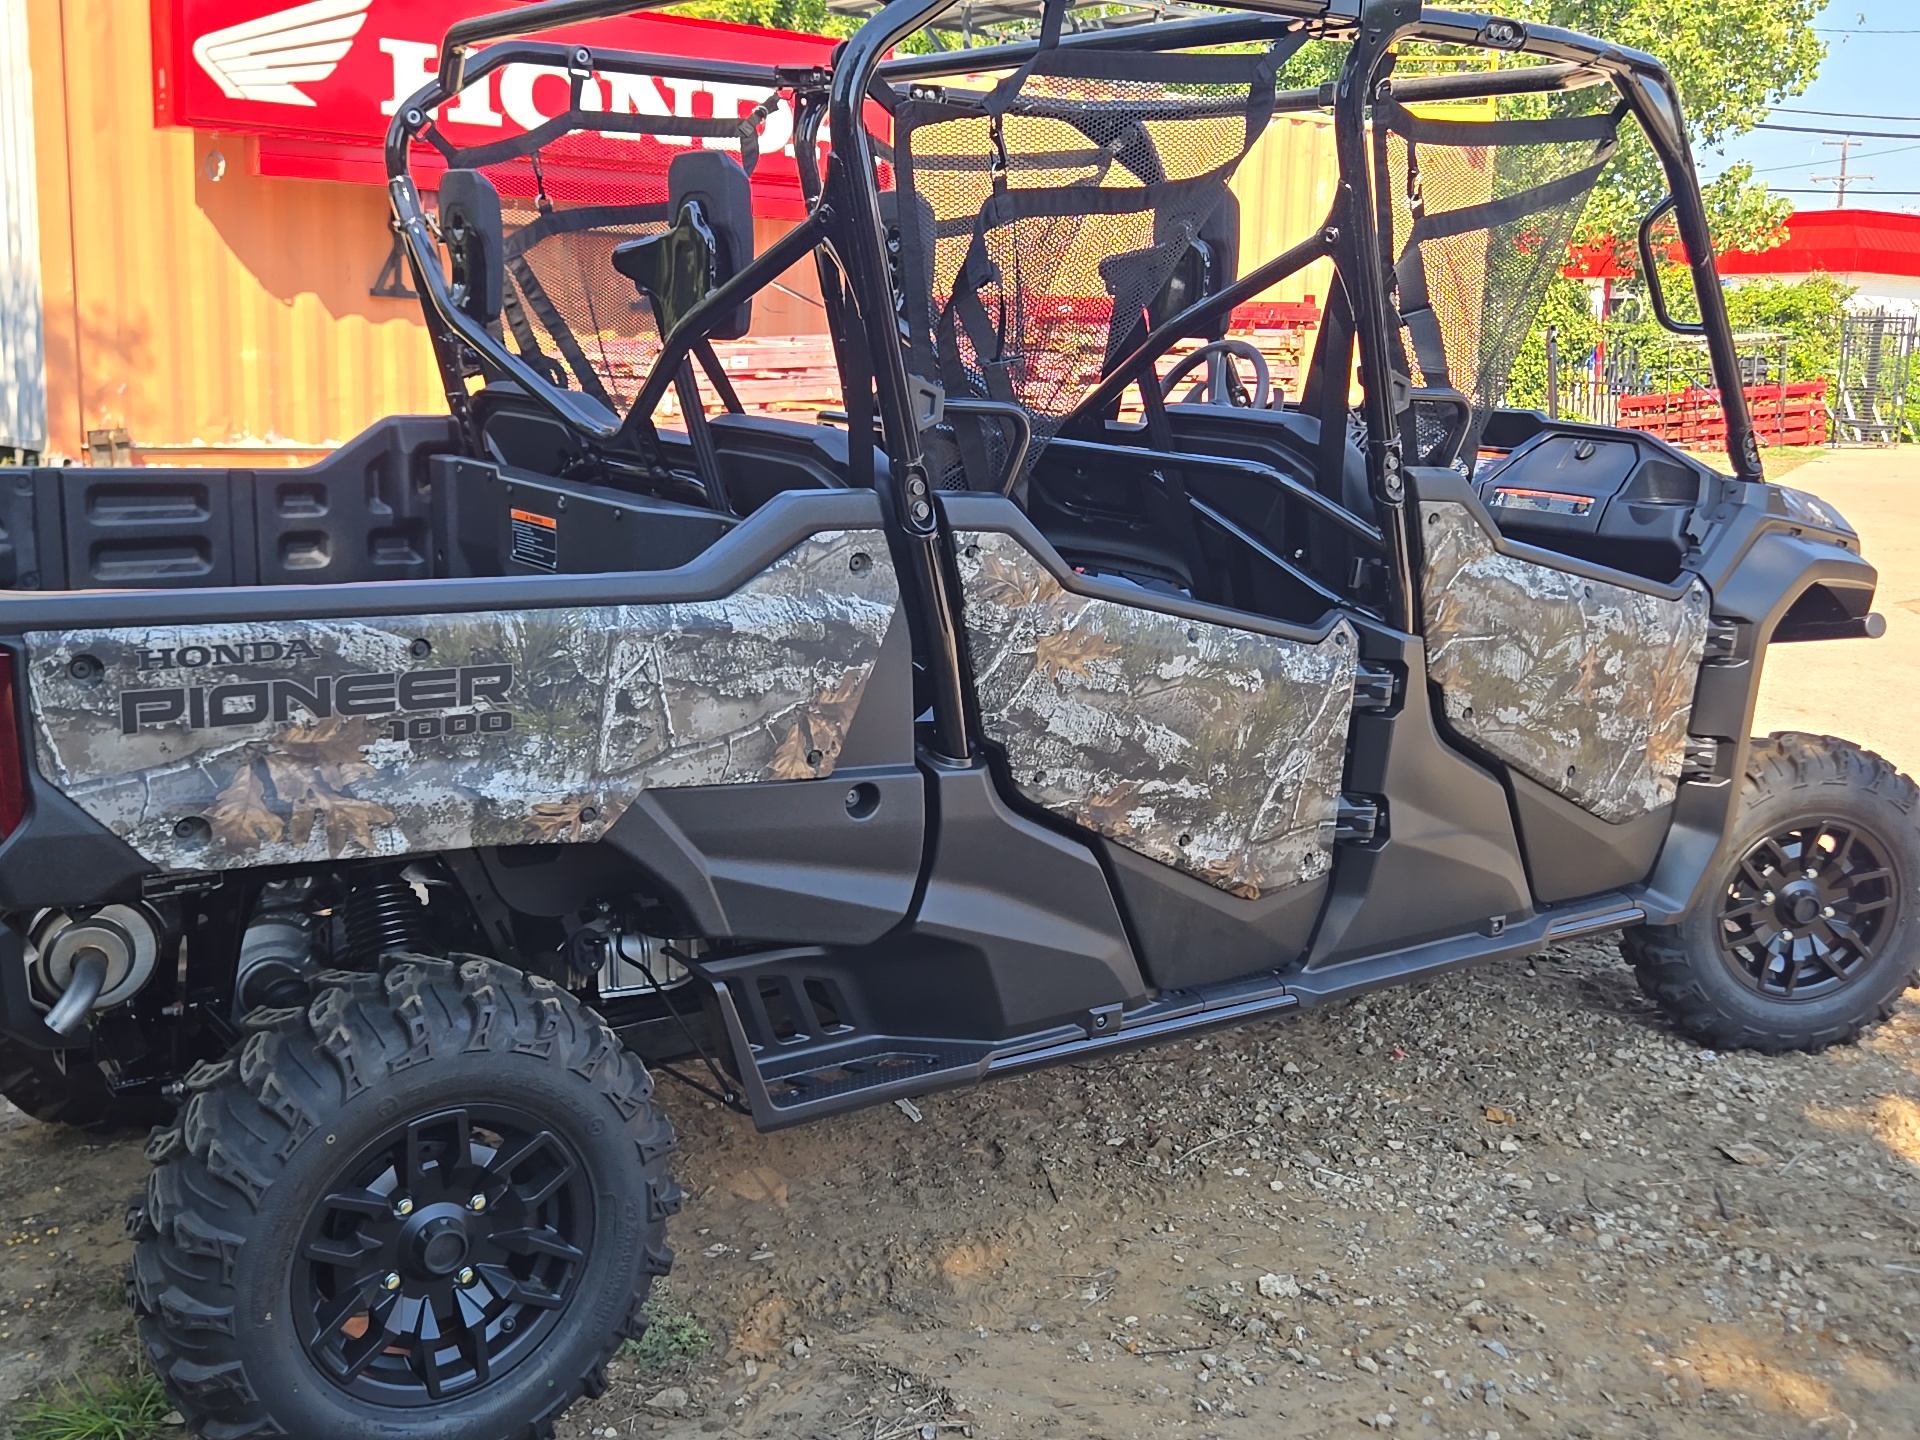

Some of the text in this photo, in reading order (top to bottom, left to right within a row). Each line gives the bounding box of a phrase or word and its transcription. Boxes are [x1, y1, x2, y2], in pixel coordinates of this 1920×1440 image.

[379, 38, 882, 165] HOND
[136, 639, 320, 671] HONDA
[120, 663, 515, 734] PIONEER
[387, 711, 514, 742] 1000
